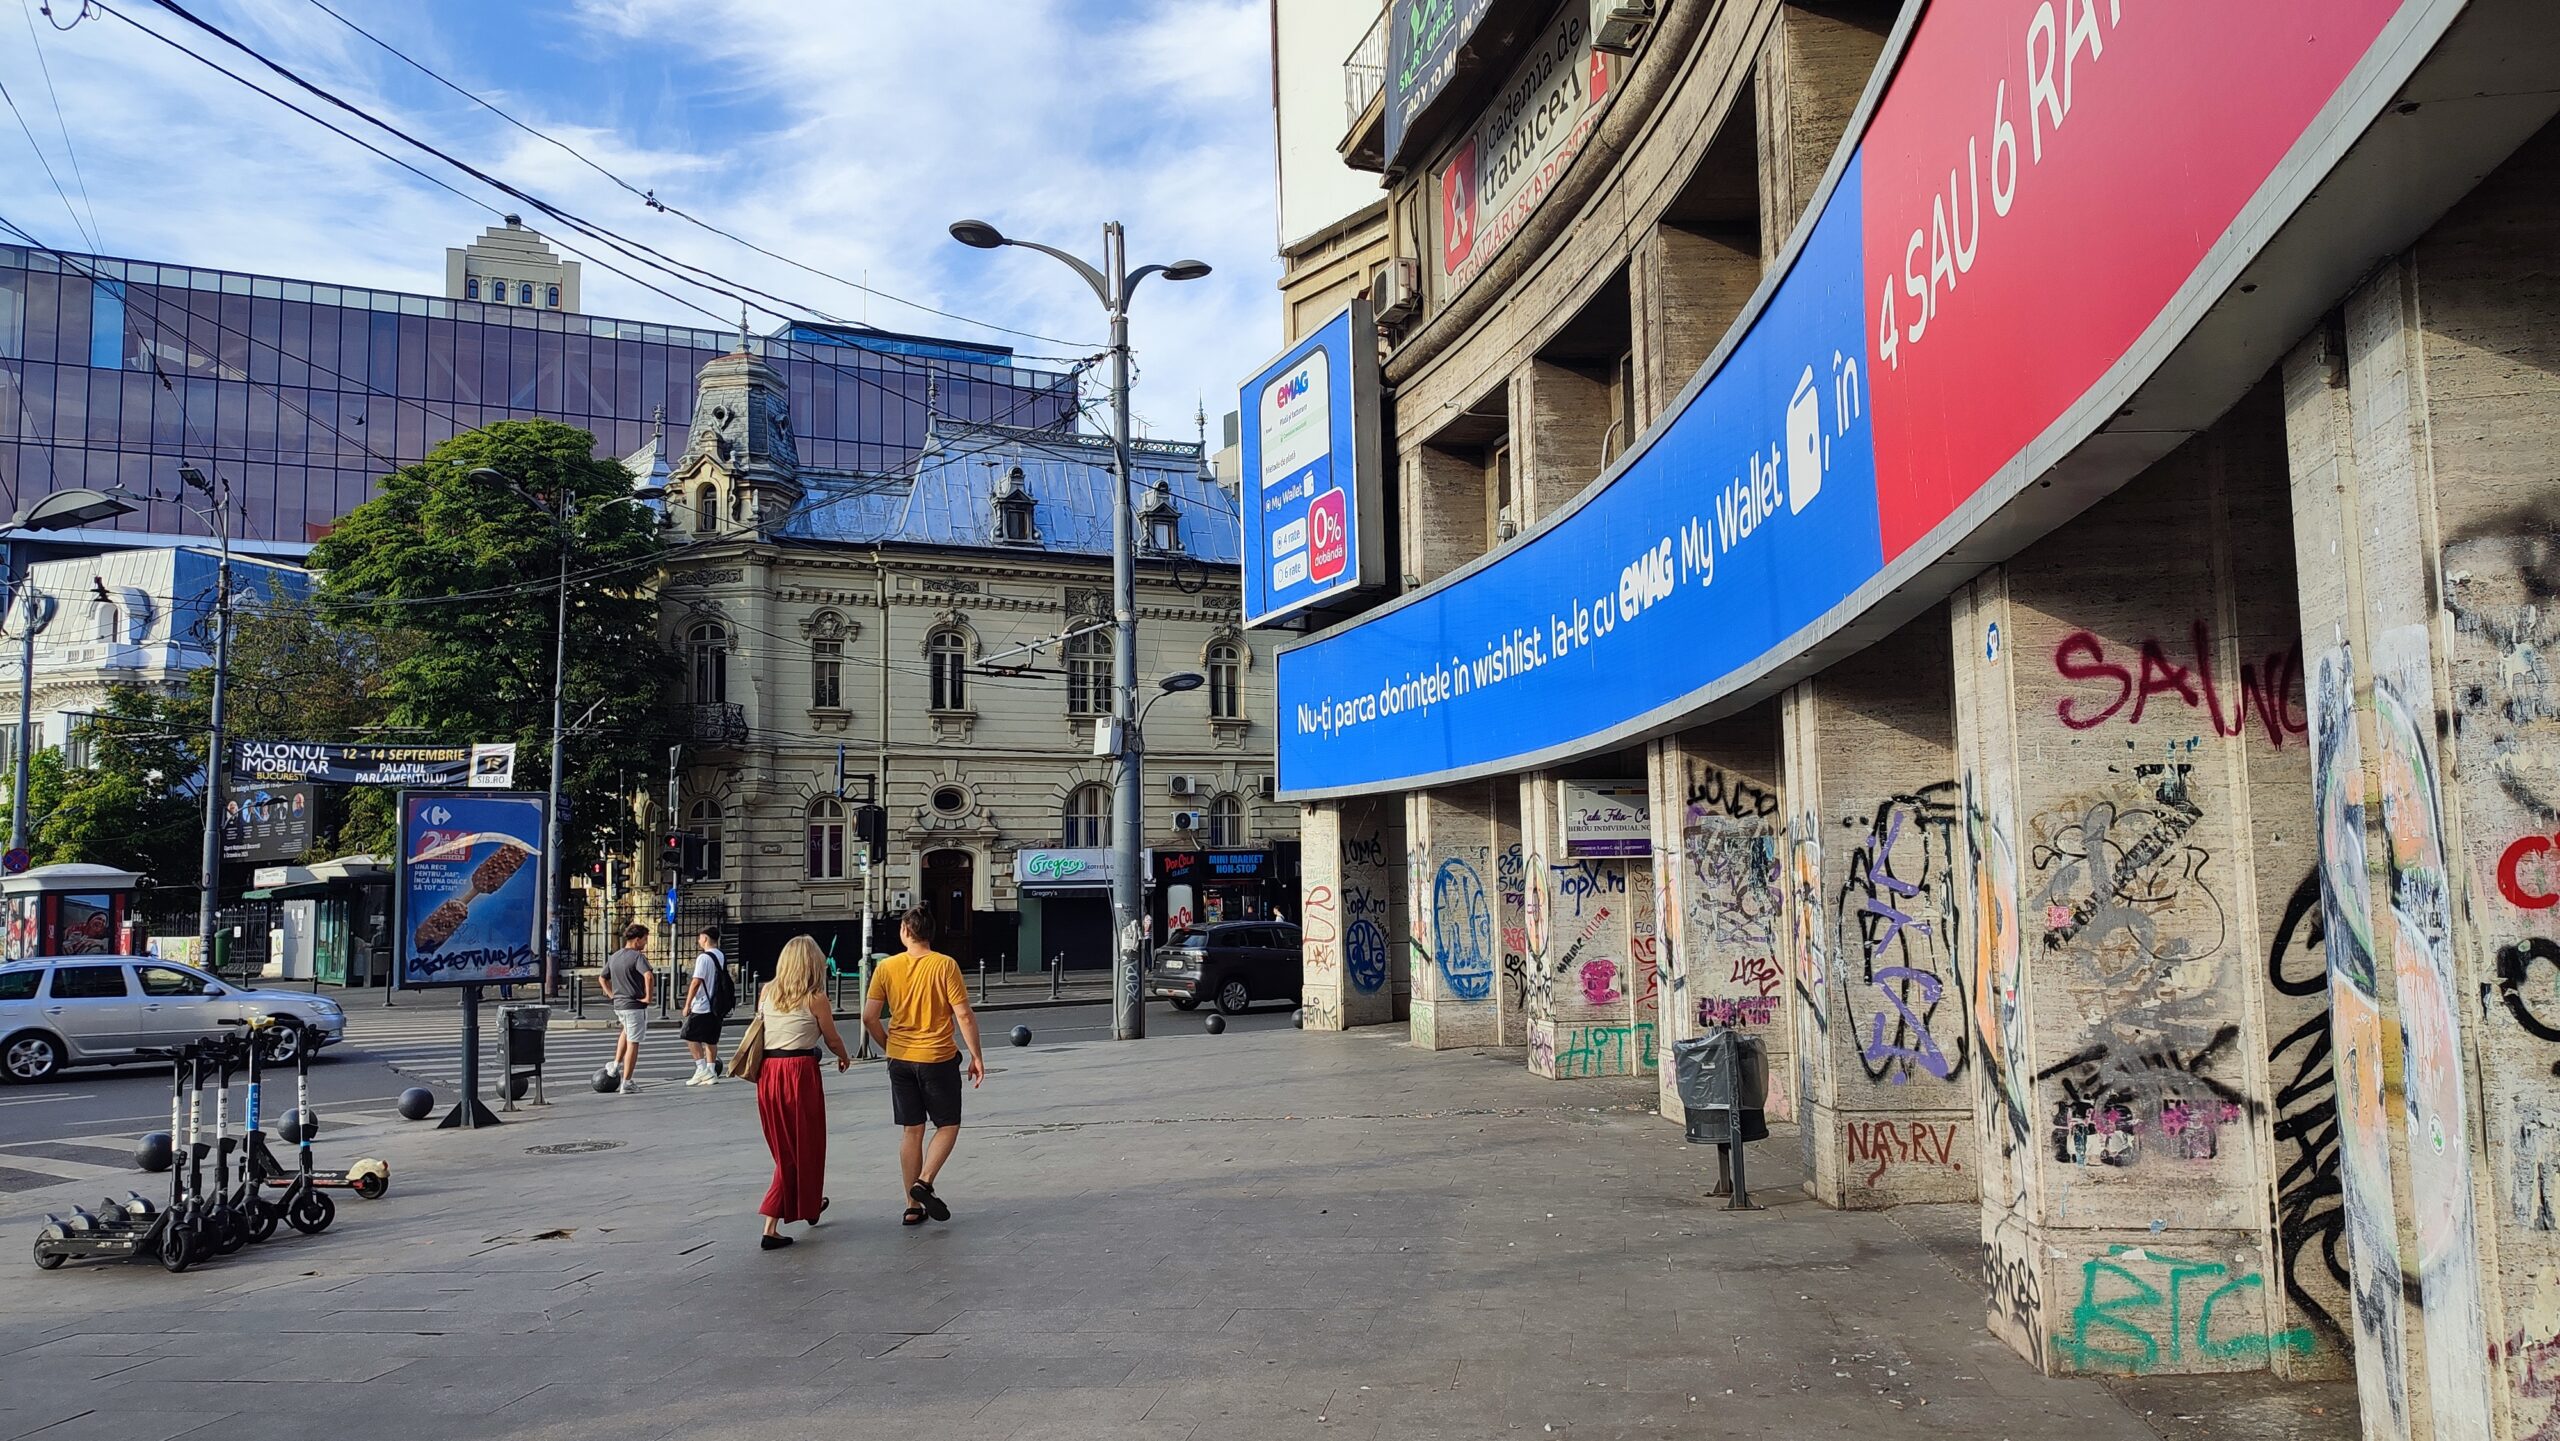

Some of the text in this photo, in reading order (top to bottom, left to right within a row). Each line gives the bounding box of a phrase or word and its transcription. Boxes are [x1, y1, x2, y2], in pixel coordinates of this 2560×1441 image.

[1557, 17, 1580, 62] de
[1430, 66, 1442, 93] TO
[1879, 0, 2121, 372] 4 SAU 6 RA
[1277, 370, 1309, 409] eMAG
[1271, 482, 1303, 511] My Wallet
[1288, 529, 1301, 544] rate
[1313, 506, 1342, 550] 0%
[1334, 687, 1376, 737] parca
[1379, 662, 1451, 719] dorințele
[1452, 656, 1471, 696] în
[1472, 627, 1547, 683] wishlist.
[1593, 592, 1615, 638] cu
[1619, 536, 1675, 622] eMAG
[1681, 516, 1714, 587] My
[1715, 440, 1784, 555] Wallet
[1832, 349, 1860, 438] în
[1314, 543, 1344, 568] dobândă
[1289, 562, 1301, 577] rate
[242, 742, 330, 761] SALONUL
[342, 748, 357, 761] 12
[370, 749, 385, 761] 14
[388, 749, 466, 762] SEPTEMBRIE
[241, 757, 330, 775] IMOBILIAR
[379, 763, 426, 774] PALATUL
[355, 773, 447, 784] PARLAMENTULUI
[477, 775, 505, 785] SIB.RO
[1208, 854, 1264, 865] MINI MARKET
[1216, 864, 1257, 874] NON-STOP
[1031, 890, 1058, 898] Gregory's
[298, 1084, 307, 1116] BIRD
[191, 1100, 200, 1134] BIRD
[220, 1097, 228, 1128] BIRD
